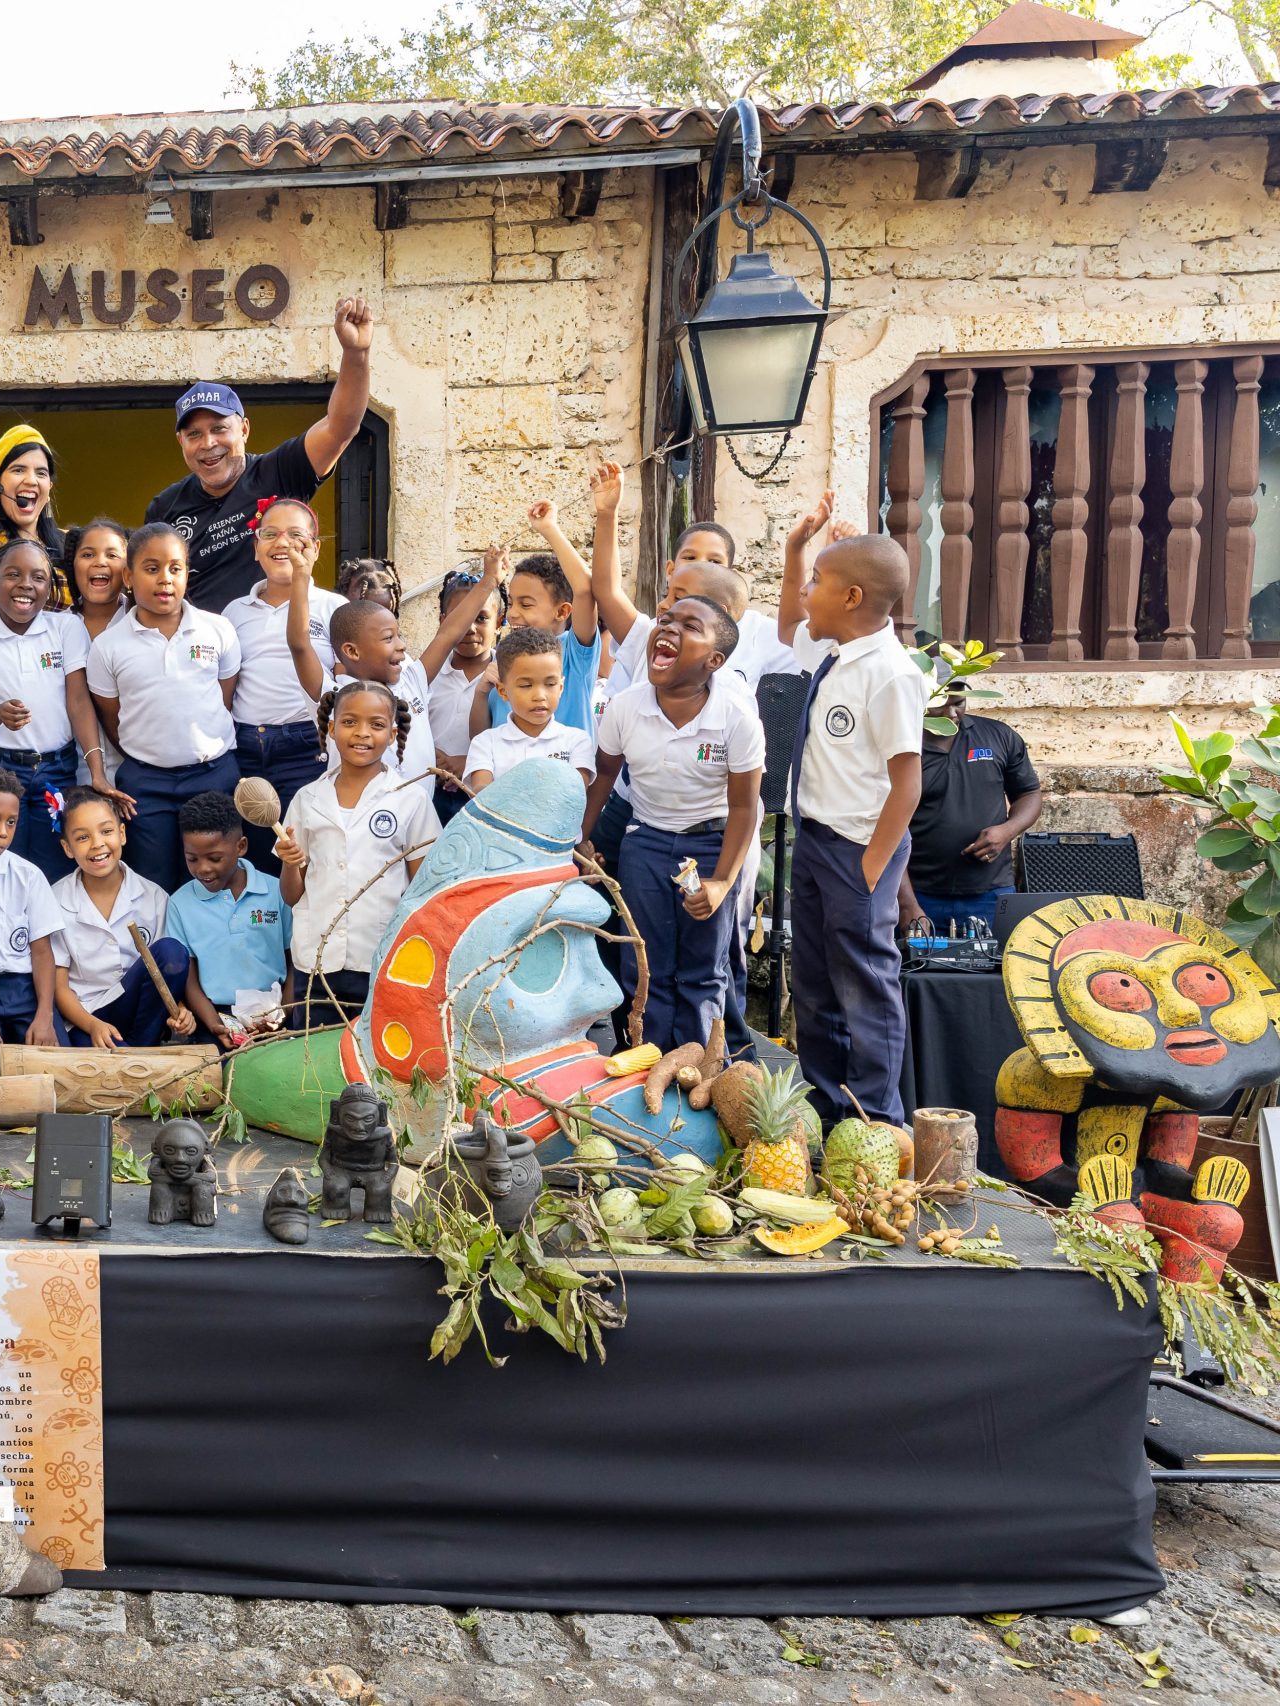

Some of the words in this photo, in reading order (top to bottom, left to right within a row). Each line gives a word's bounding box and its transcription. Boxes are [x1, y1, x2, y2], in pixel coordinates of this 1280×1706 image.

[24, 264, 290, 327] MUSEO
[199, 546, 211, 557] EN
[211, 539, 229, 552] SON
[230, 534, 240, 544] DE
[18, 1371, 32, 1379] un
[19, 1383, 32, 1392] de
[14, 1425, 33, 1433] Los
[2, 1464, 34, 1474] forma
[9, 1478, 35, 1487] boca
[25, 1491, 35, 1500] la
